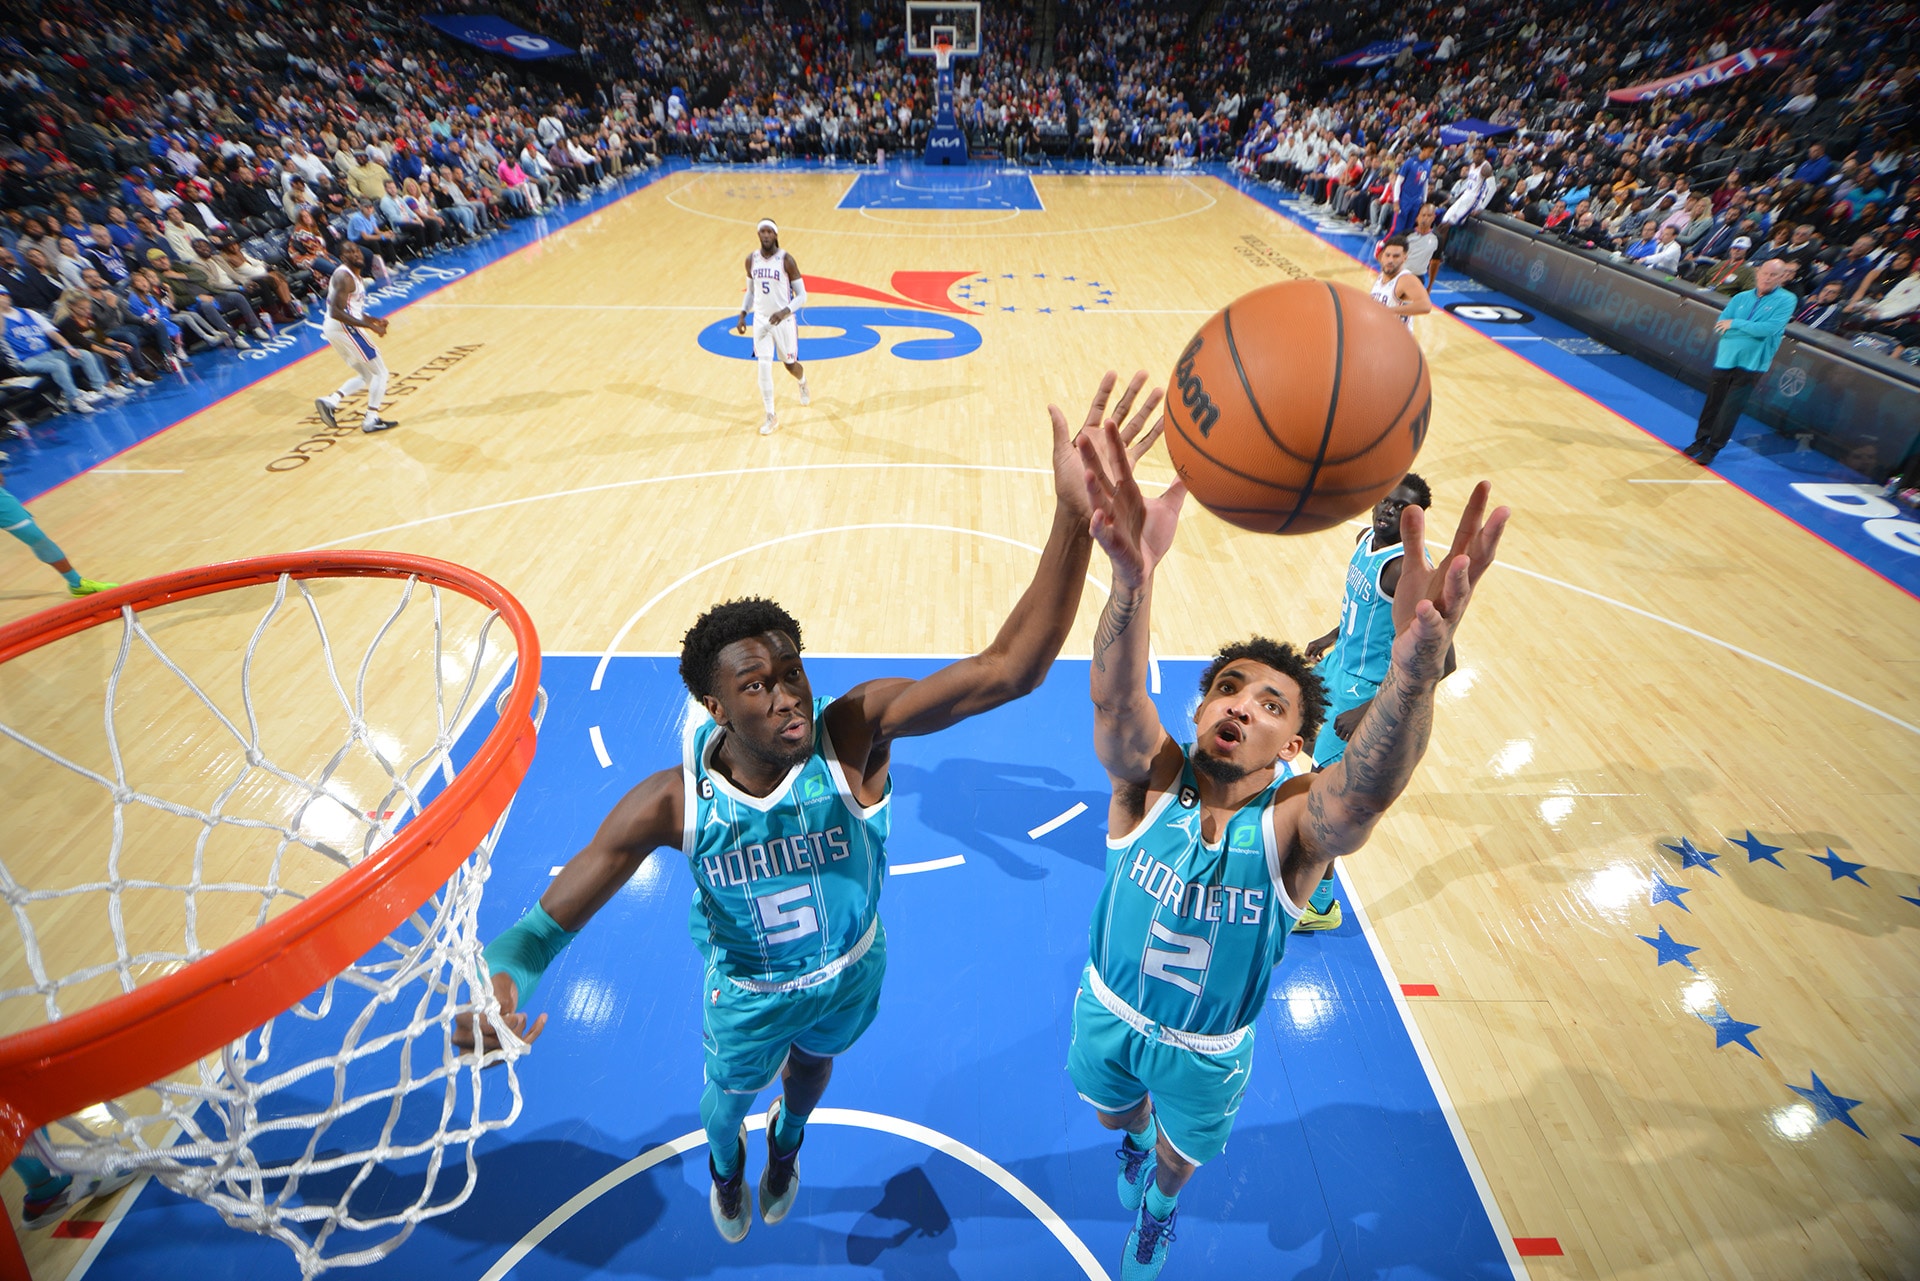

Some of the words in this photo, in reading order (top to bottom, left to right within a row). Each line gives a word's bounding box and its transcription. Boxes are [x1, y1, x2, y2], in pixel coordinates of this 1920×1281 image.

[752, 268, 780, 281] PHILA
[761, 281, 770, 295] 5
[1180, 788, 1196, 807] 6
[703, 825, 851, 888] HORNETS
[1128, 848, 1266, 925] HORNETS
[756, 883, 820, 946] 5
[1142, 919, 1213, 998] 2
